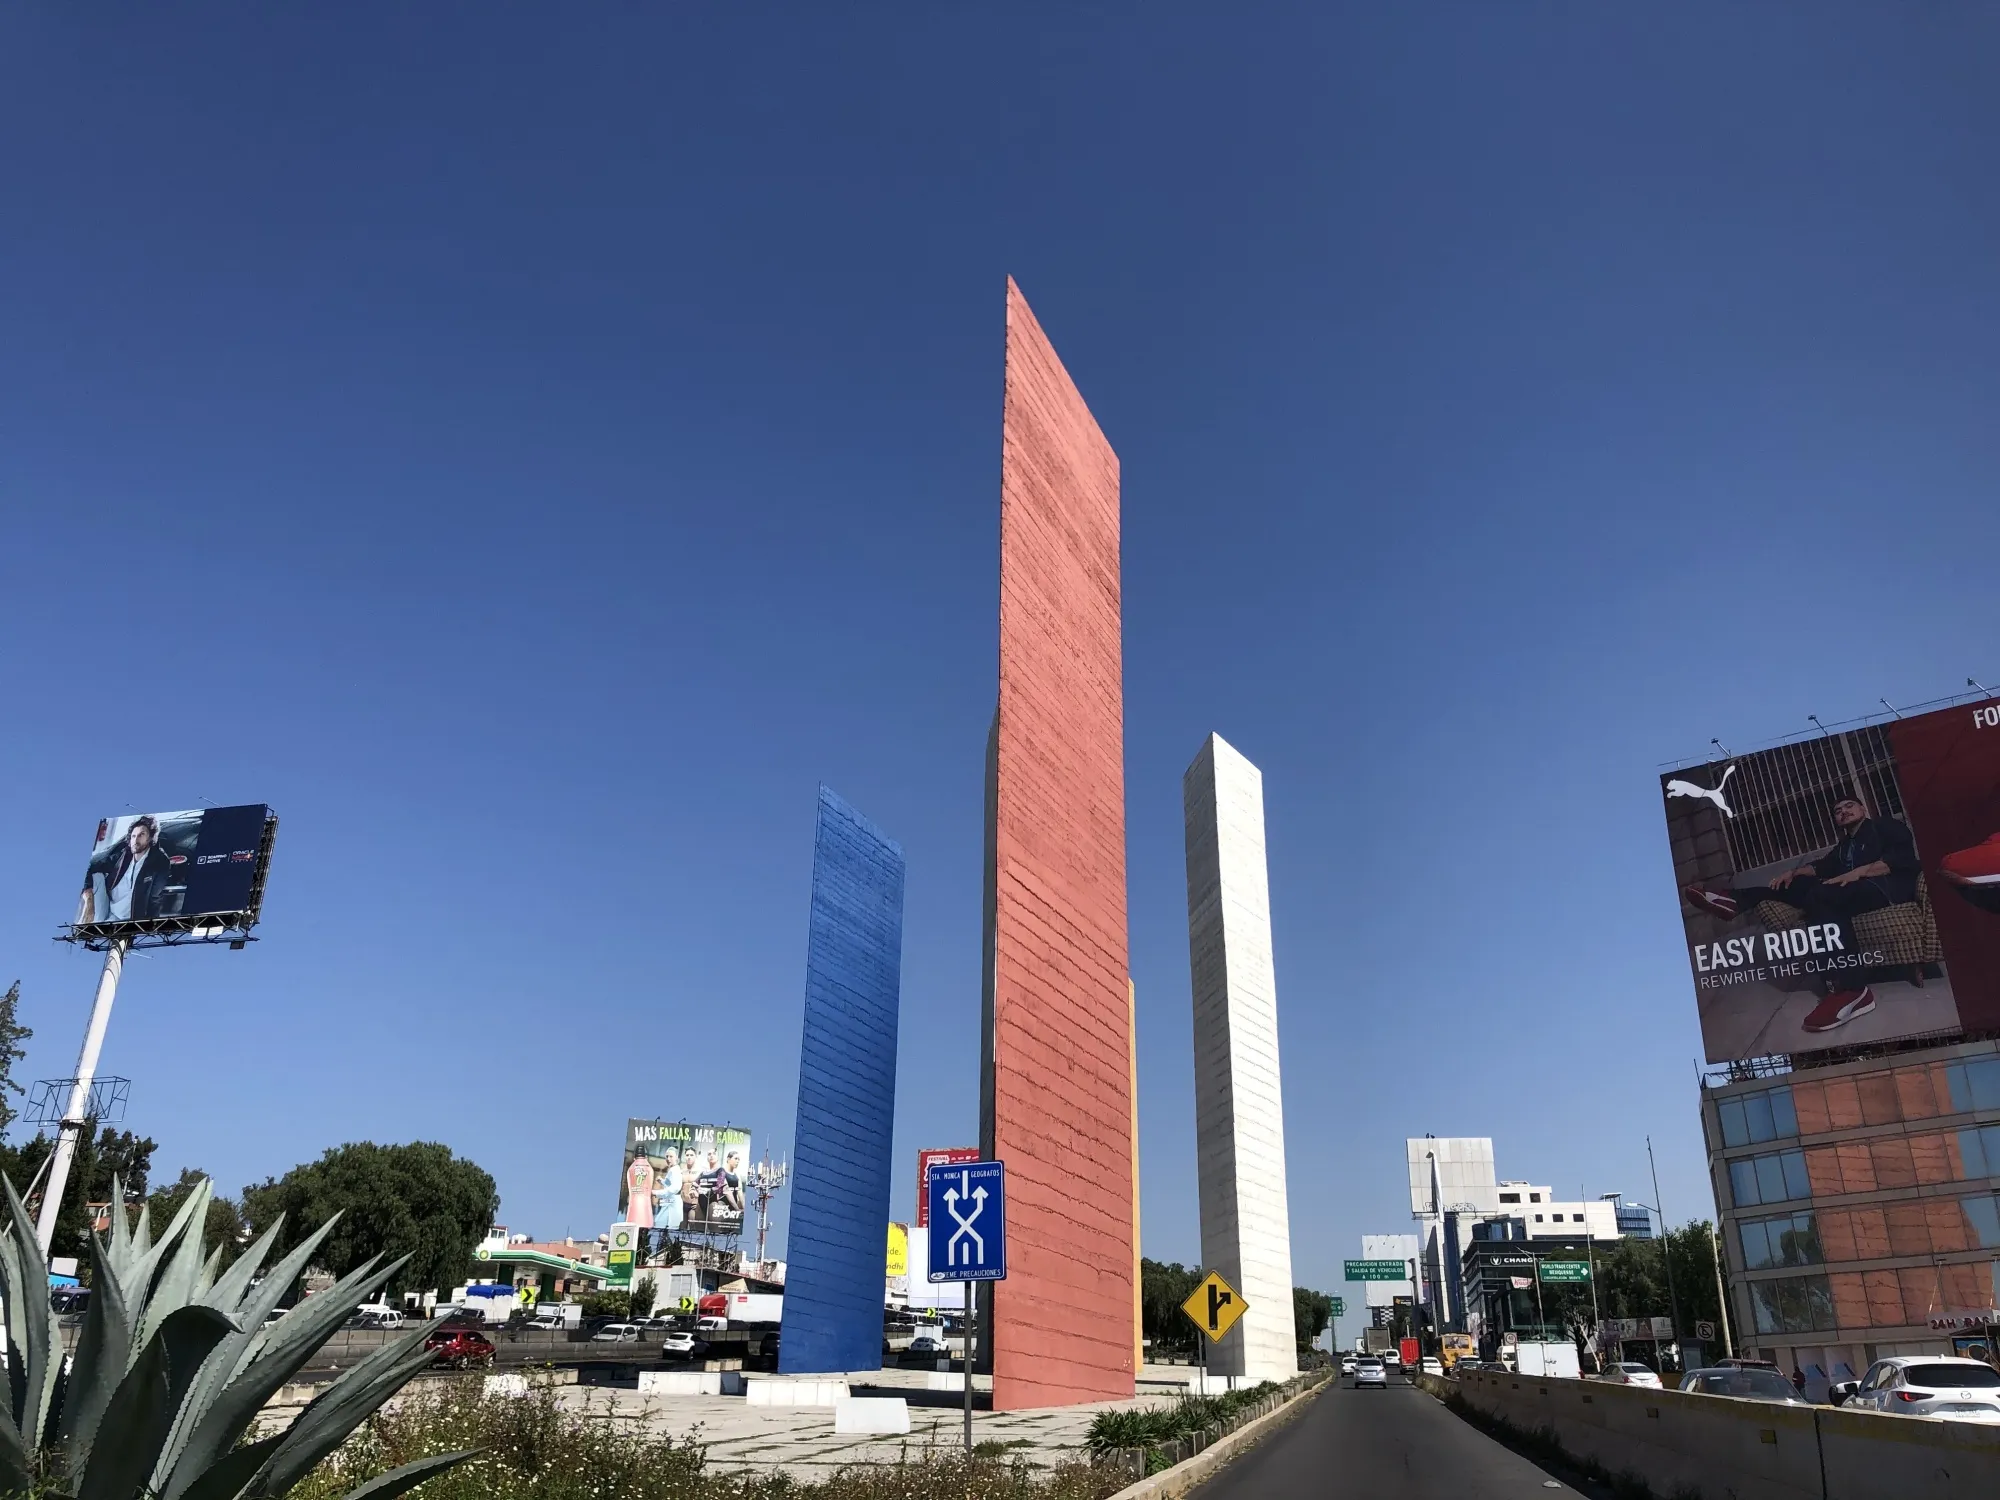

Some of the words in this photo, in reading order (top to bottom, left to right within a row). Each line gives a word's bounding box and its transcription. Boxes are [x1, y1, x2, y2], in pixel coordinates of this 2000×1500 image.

[1694, 936, 1755, 972] EASY
[1764, 923, 1845, 961] RIDER
[1700, 967, 1766, 989] REWRITE
[1770, 962, 1800, 980] THE
[1805, 950, 1884, 973] CLASSICS
[659, 1126, 691, 1142] FALLAS,
[970, 1169, 1000, 1178] GEOGRAFOS
[712, 1209, 741, 1219] SPORT
[960, 1268, 1001, 1278] PRECAUCIONES
